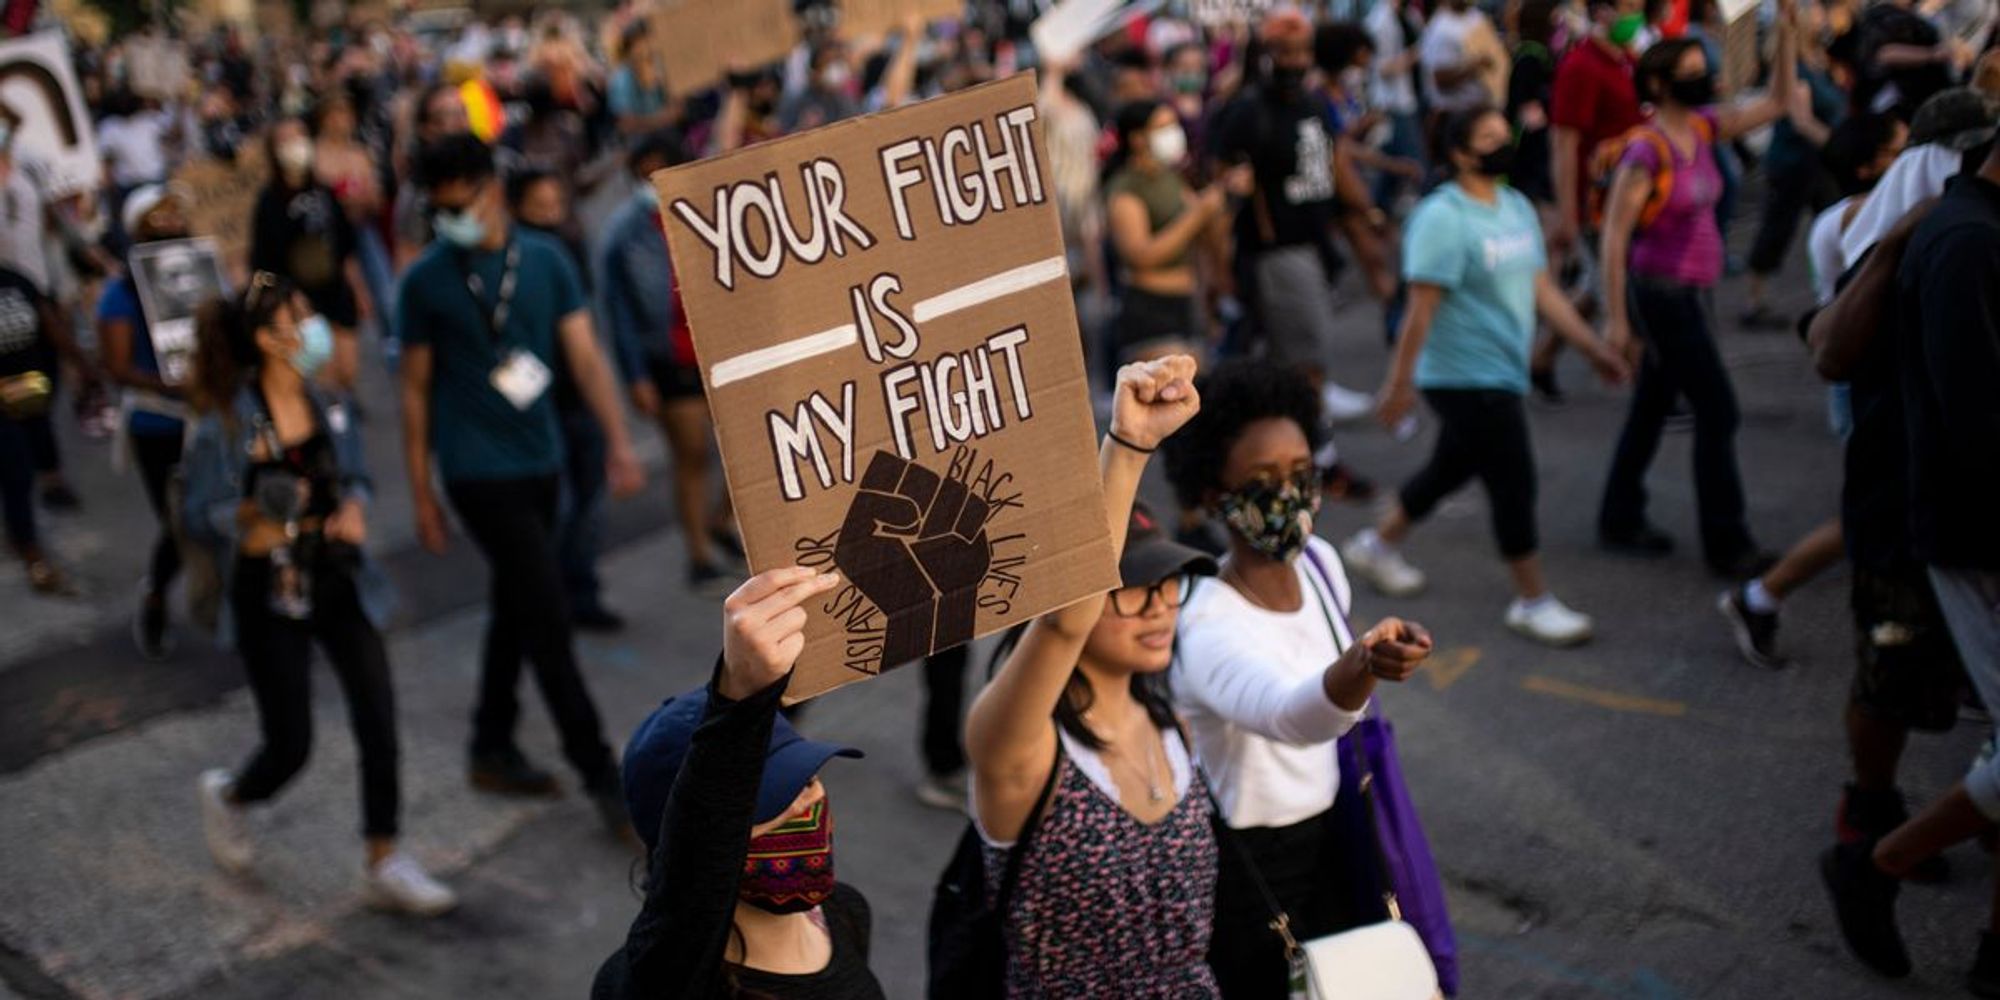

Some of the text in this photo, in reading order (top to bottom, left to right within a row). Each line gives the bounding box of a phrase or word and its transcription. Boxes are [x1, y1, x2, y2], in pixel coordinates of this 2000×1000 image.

[671, 104, 1045, 291] YOUR FIGHT
[850, 273, 921, 363] IS
[766, 323, 1033, 502] MY FIGHT
[795, 445, 1026, 676] ASIANS OR BLACK LIVES
